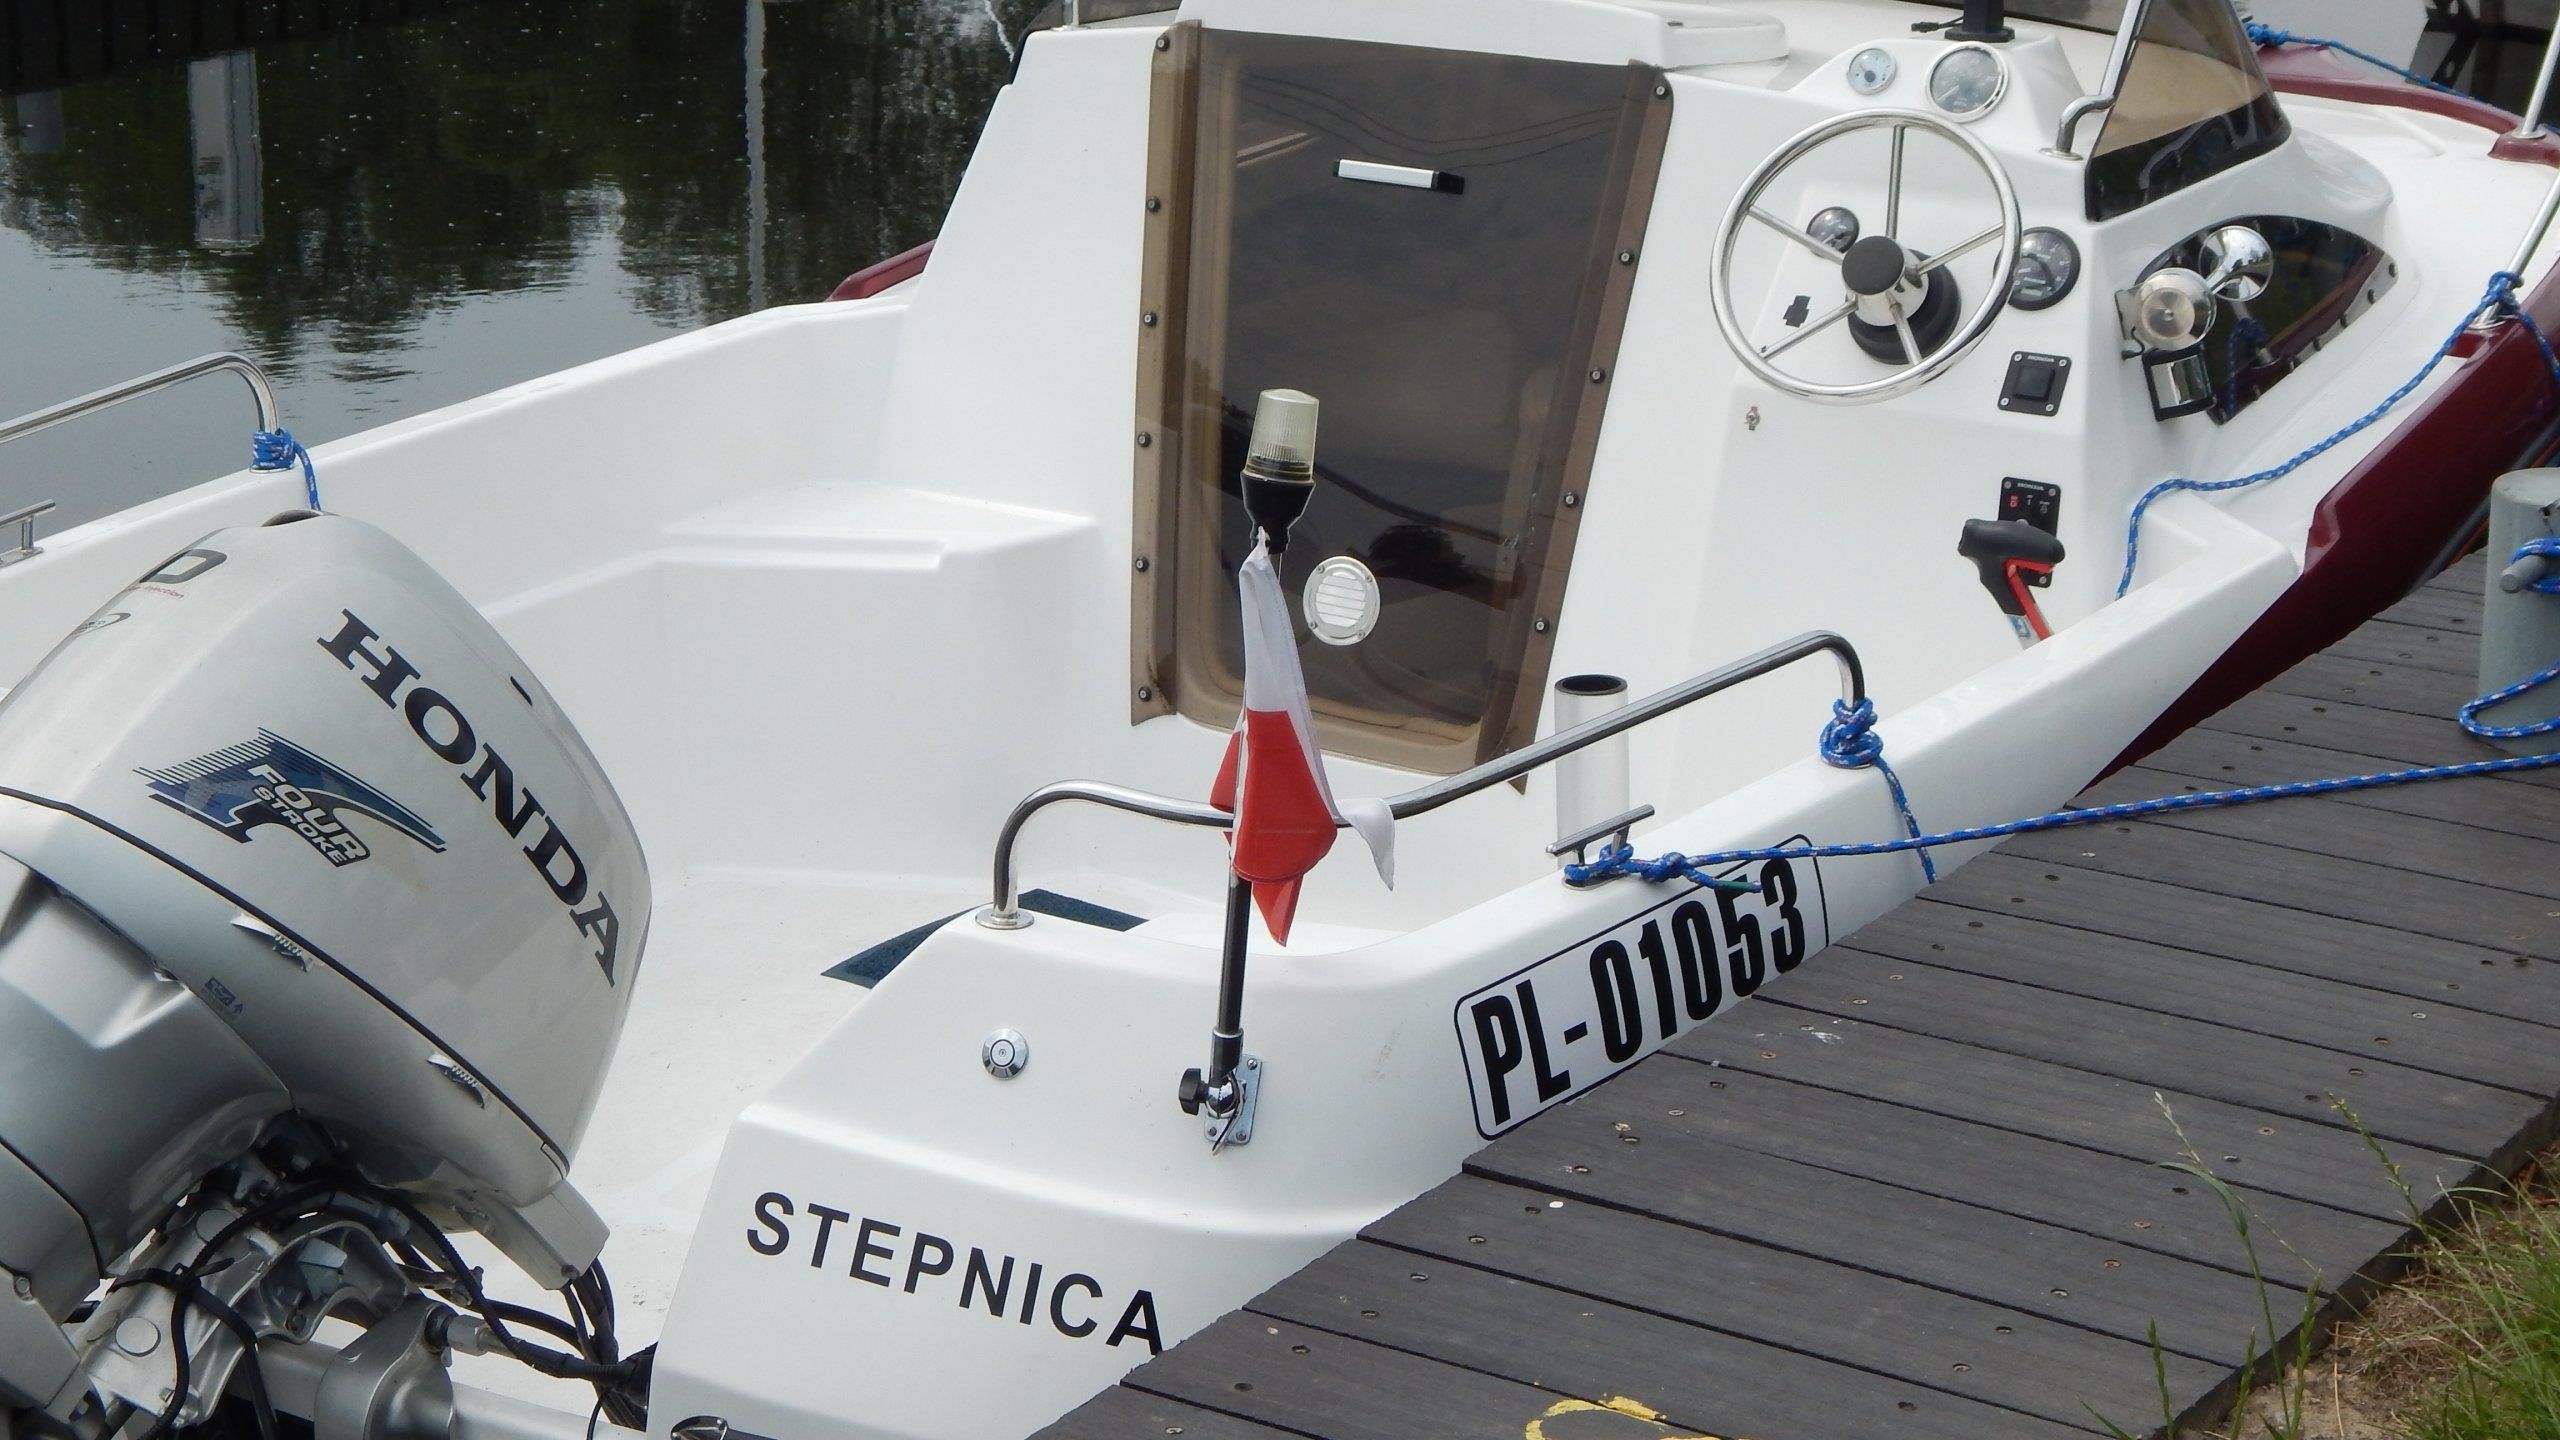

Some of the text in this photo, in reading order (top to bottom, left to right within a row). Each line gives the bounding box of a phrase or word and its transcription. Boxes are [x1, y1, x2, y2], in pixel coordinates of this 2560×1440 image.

[247, 763, 368, 860] FOUR
[253, 786, 348, 863] STROKE
[317, 608, 621, 987] HONDA
[1470, 857, 1806, 1126] PL-01053
[746, 1191, 1164, 1356] STEPNICA
